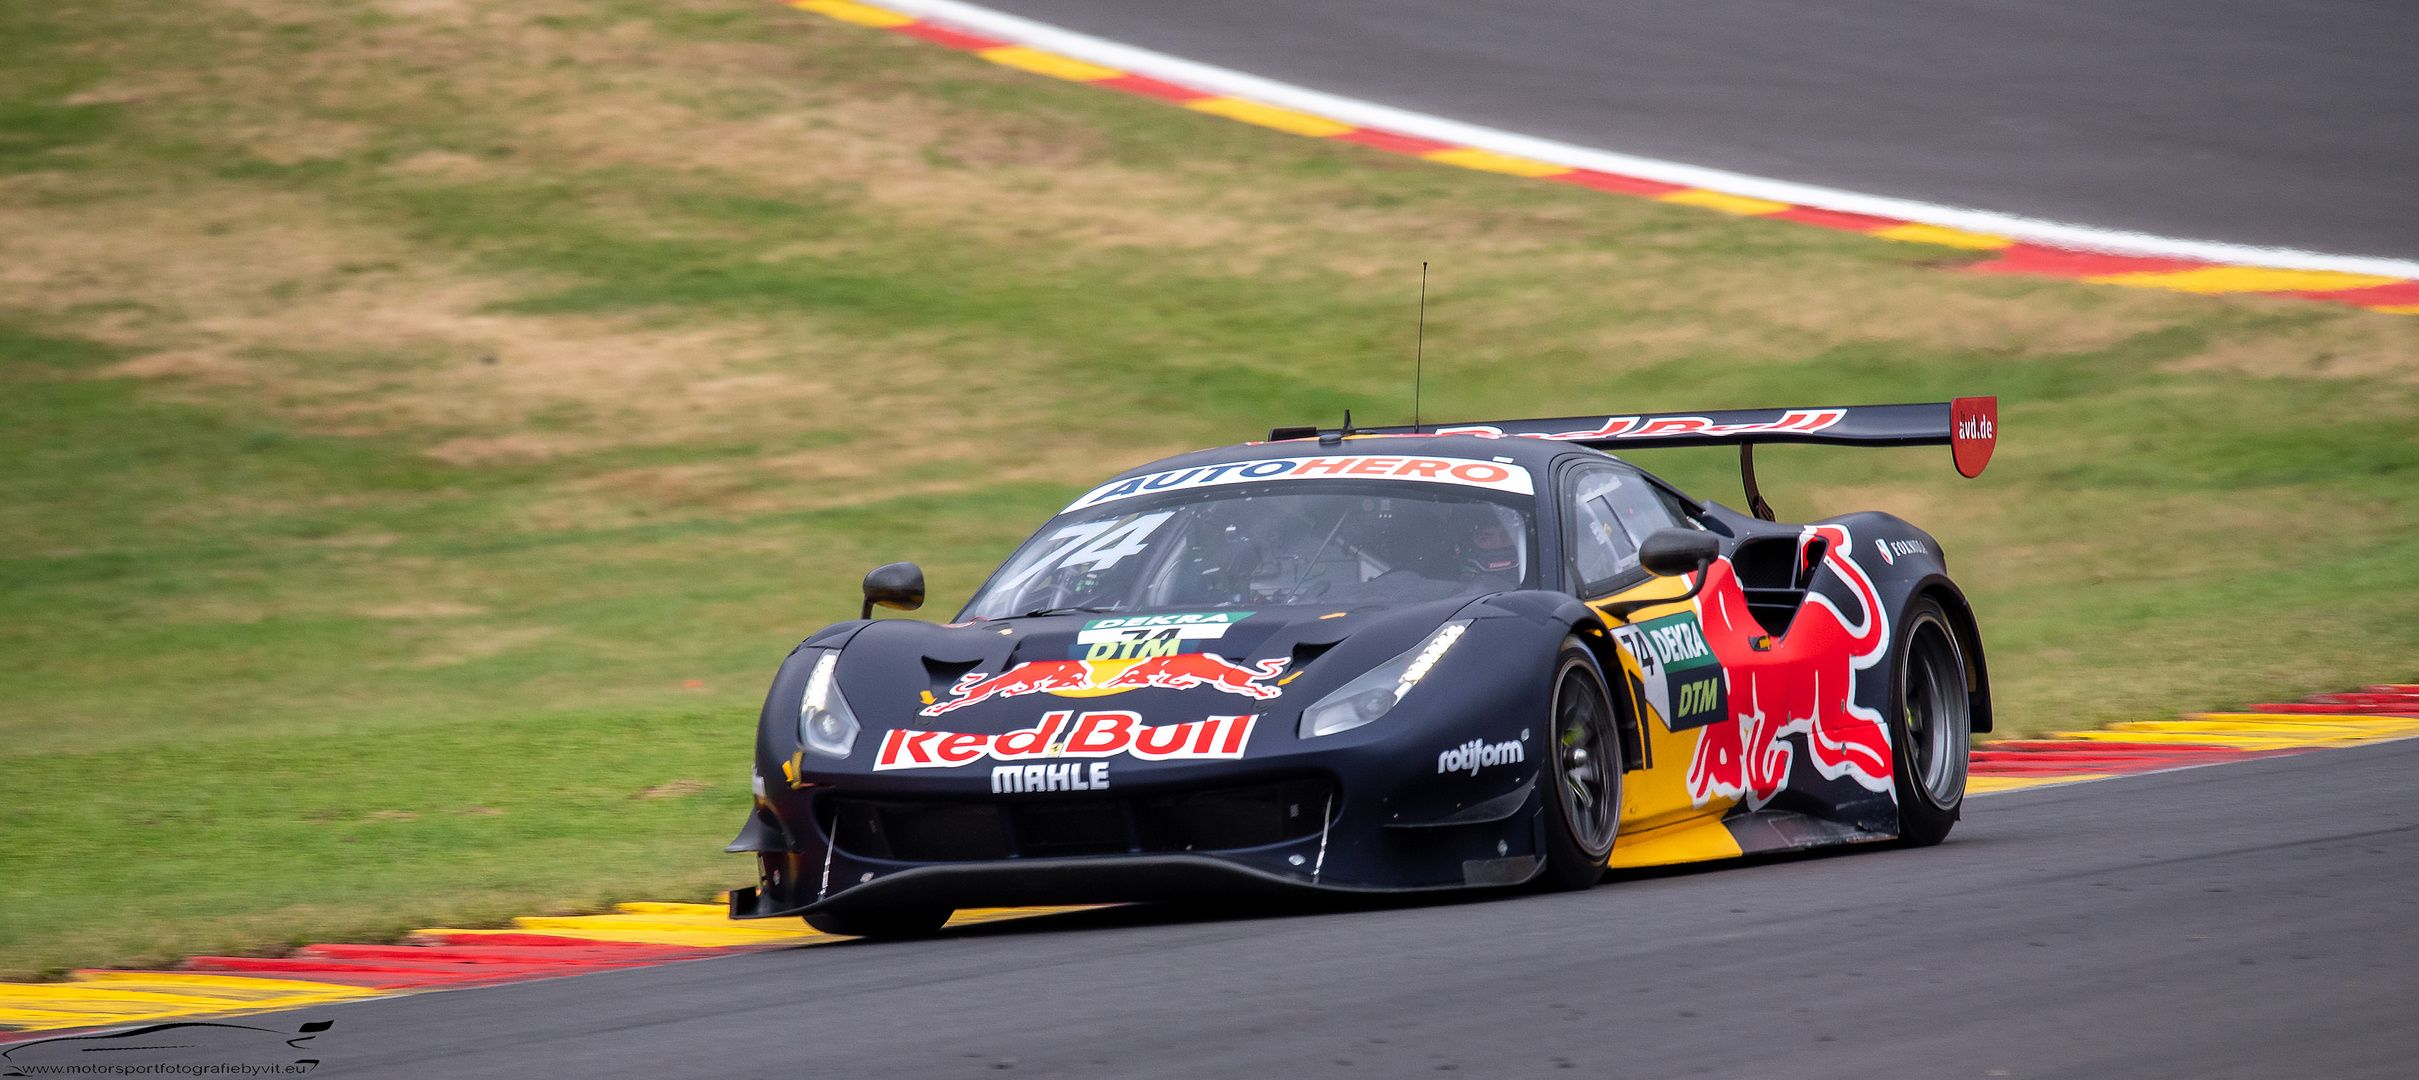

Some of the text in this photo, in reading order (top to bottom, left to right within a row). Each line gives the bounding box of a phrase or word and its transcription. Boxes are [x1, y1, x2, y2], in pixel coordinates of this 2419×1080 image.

[1959, 414, 1992, 439] avd.de
[1088, 457, 1509, 503] AUTOHERO
[995, 511, 1176, 594] 74
[1092, 613, 1229, 629] DEKRA
[1085, 638, 1182, 661] DTM
[1650, 620, 1709, 664] DEKRA
[1678, 677, 1718, 718] DTM
[873, 710, 1259, 771] Red Bull
[1438, 738, 1525, 777] rotiform
[991, 761, 1110, 793] MAHLE
